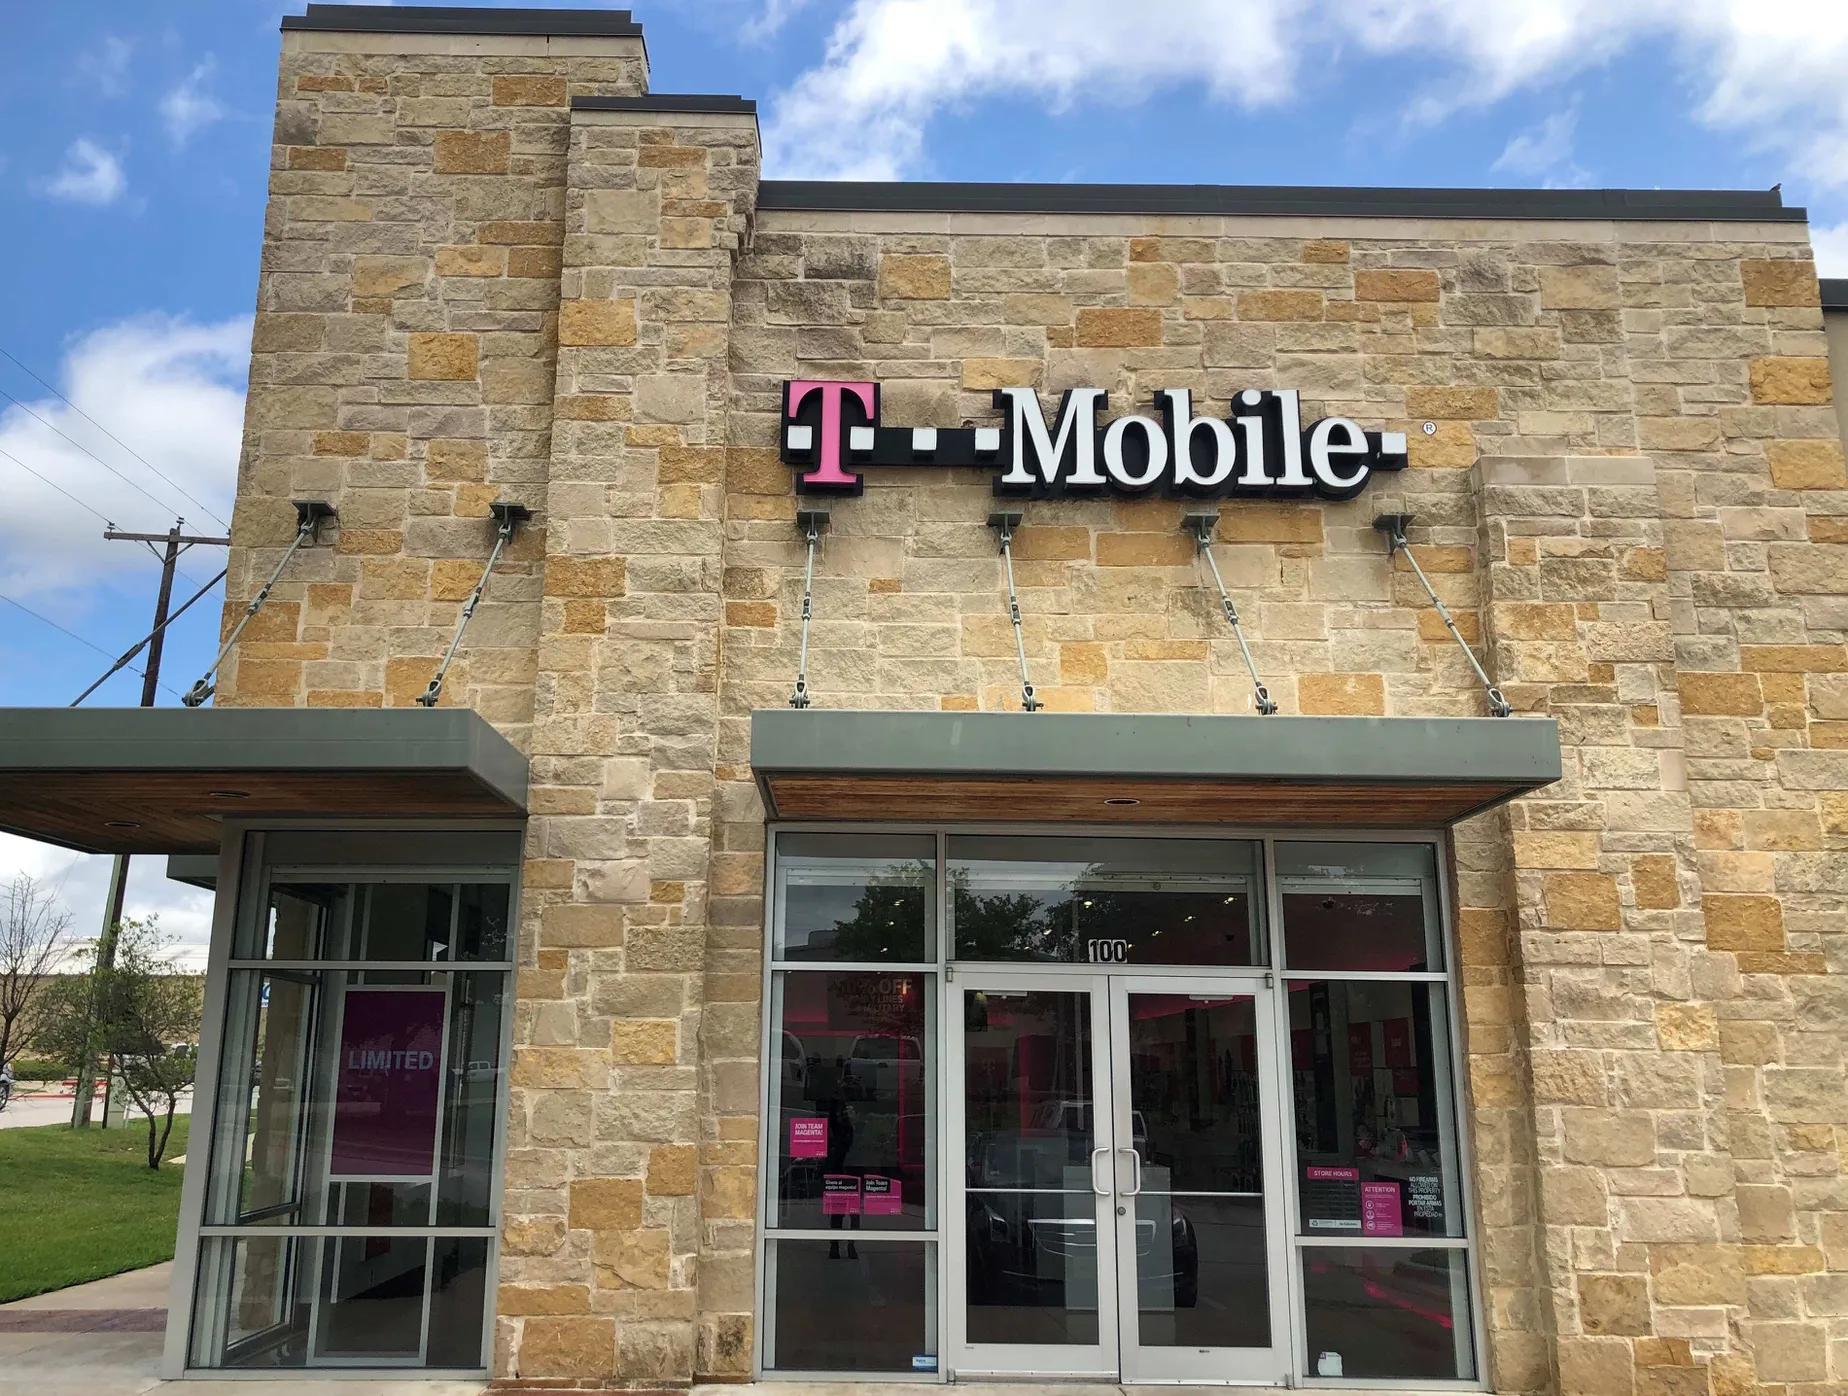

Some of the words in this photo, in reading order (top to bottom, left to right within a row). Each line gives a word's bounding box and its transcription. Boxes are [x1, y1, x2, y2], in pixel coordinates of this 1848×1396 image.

[1090, 940, 1126, 962] 100
[879, 978, 913, 995] OFF
[348, 1050, 434, 1070] LIMITED
